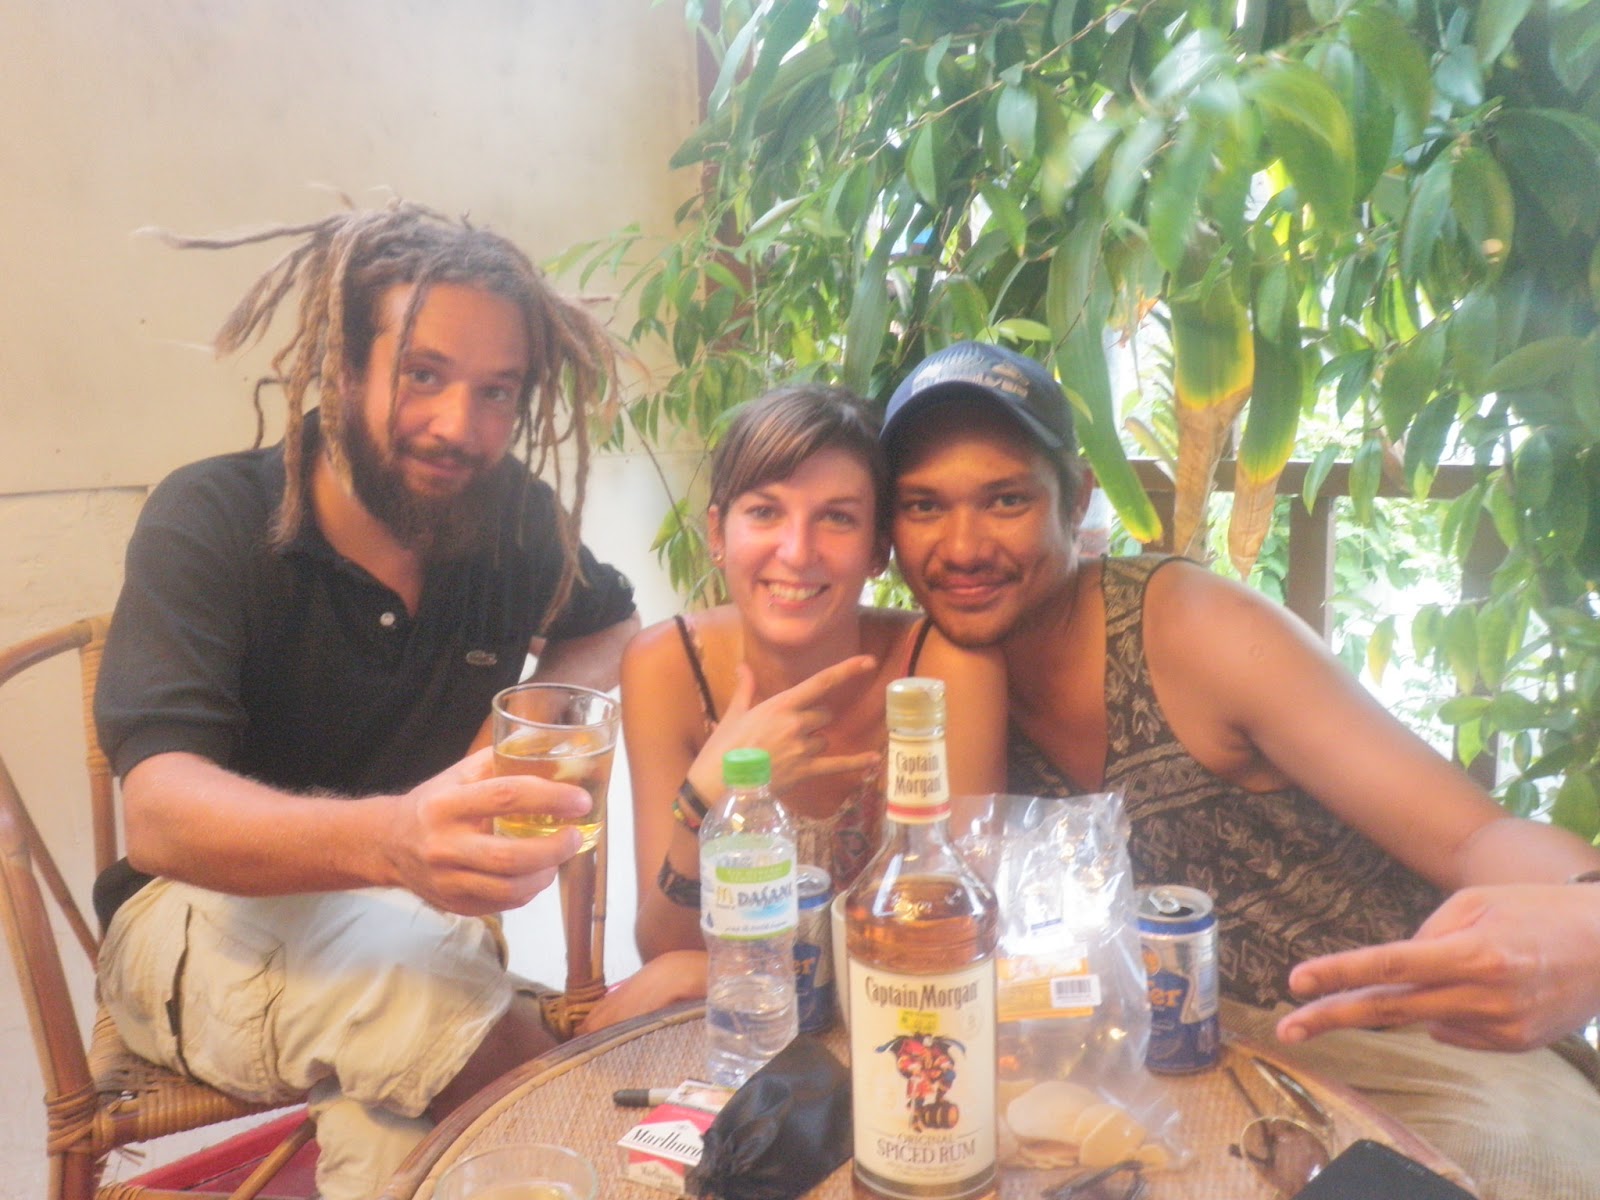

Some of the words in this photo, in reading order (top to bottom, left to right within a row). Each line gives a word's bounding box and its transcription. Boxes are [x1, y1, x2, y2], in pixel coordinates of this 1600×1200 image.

[895, 752, 939, 774] Captain
[895, 774, 941, 796] Morgan
[737, 882, 792, 910] DASANI
[865, 976, 919, 1008] Captain
[919, 980, 978, 1011] Morgan
[632, 1128, 703, 1157] Marlboro
[877, 1138, 935, 1164] SPICED
[939, 1139, 976, 1164] RUM
